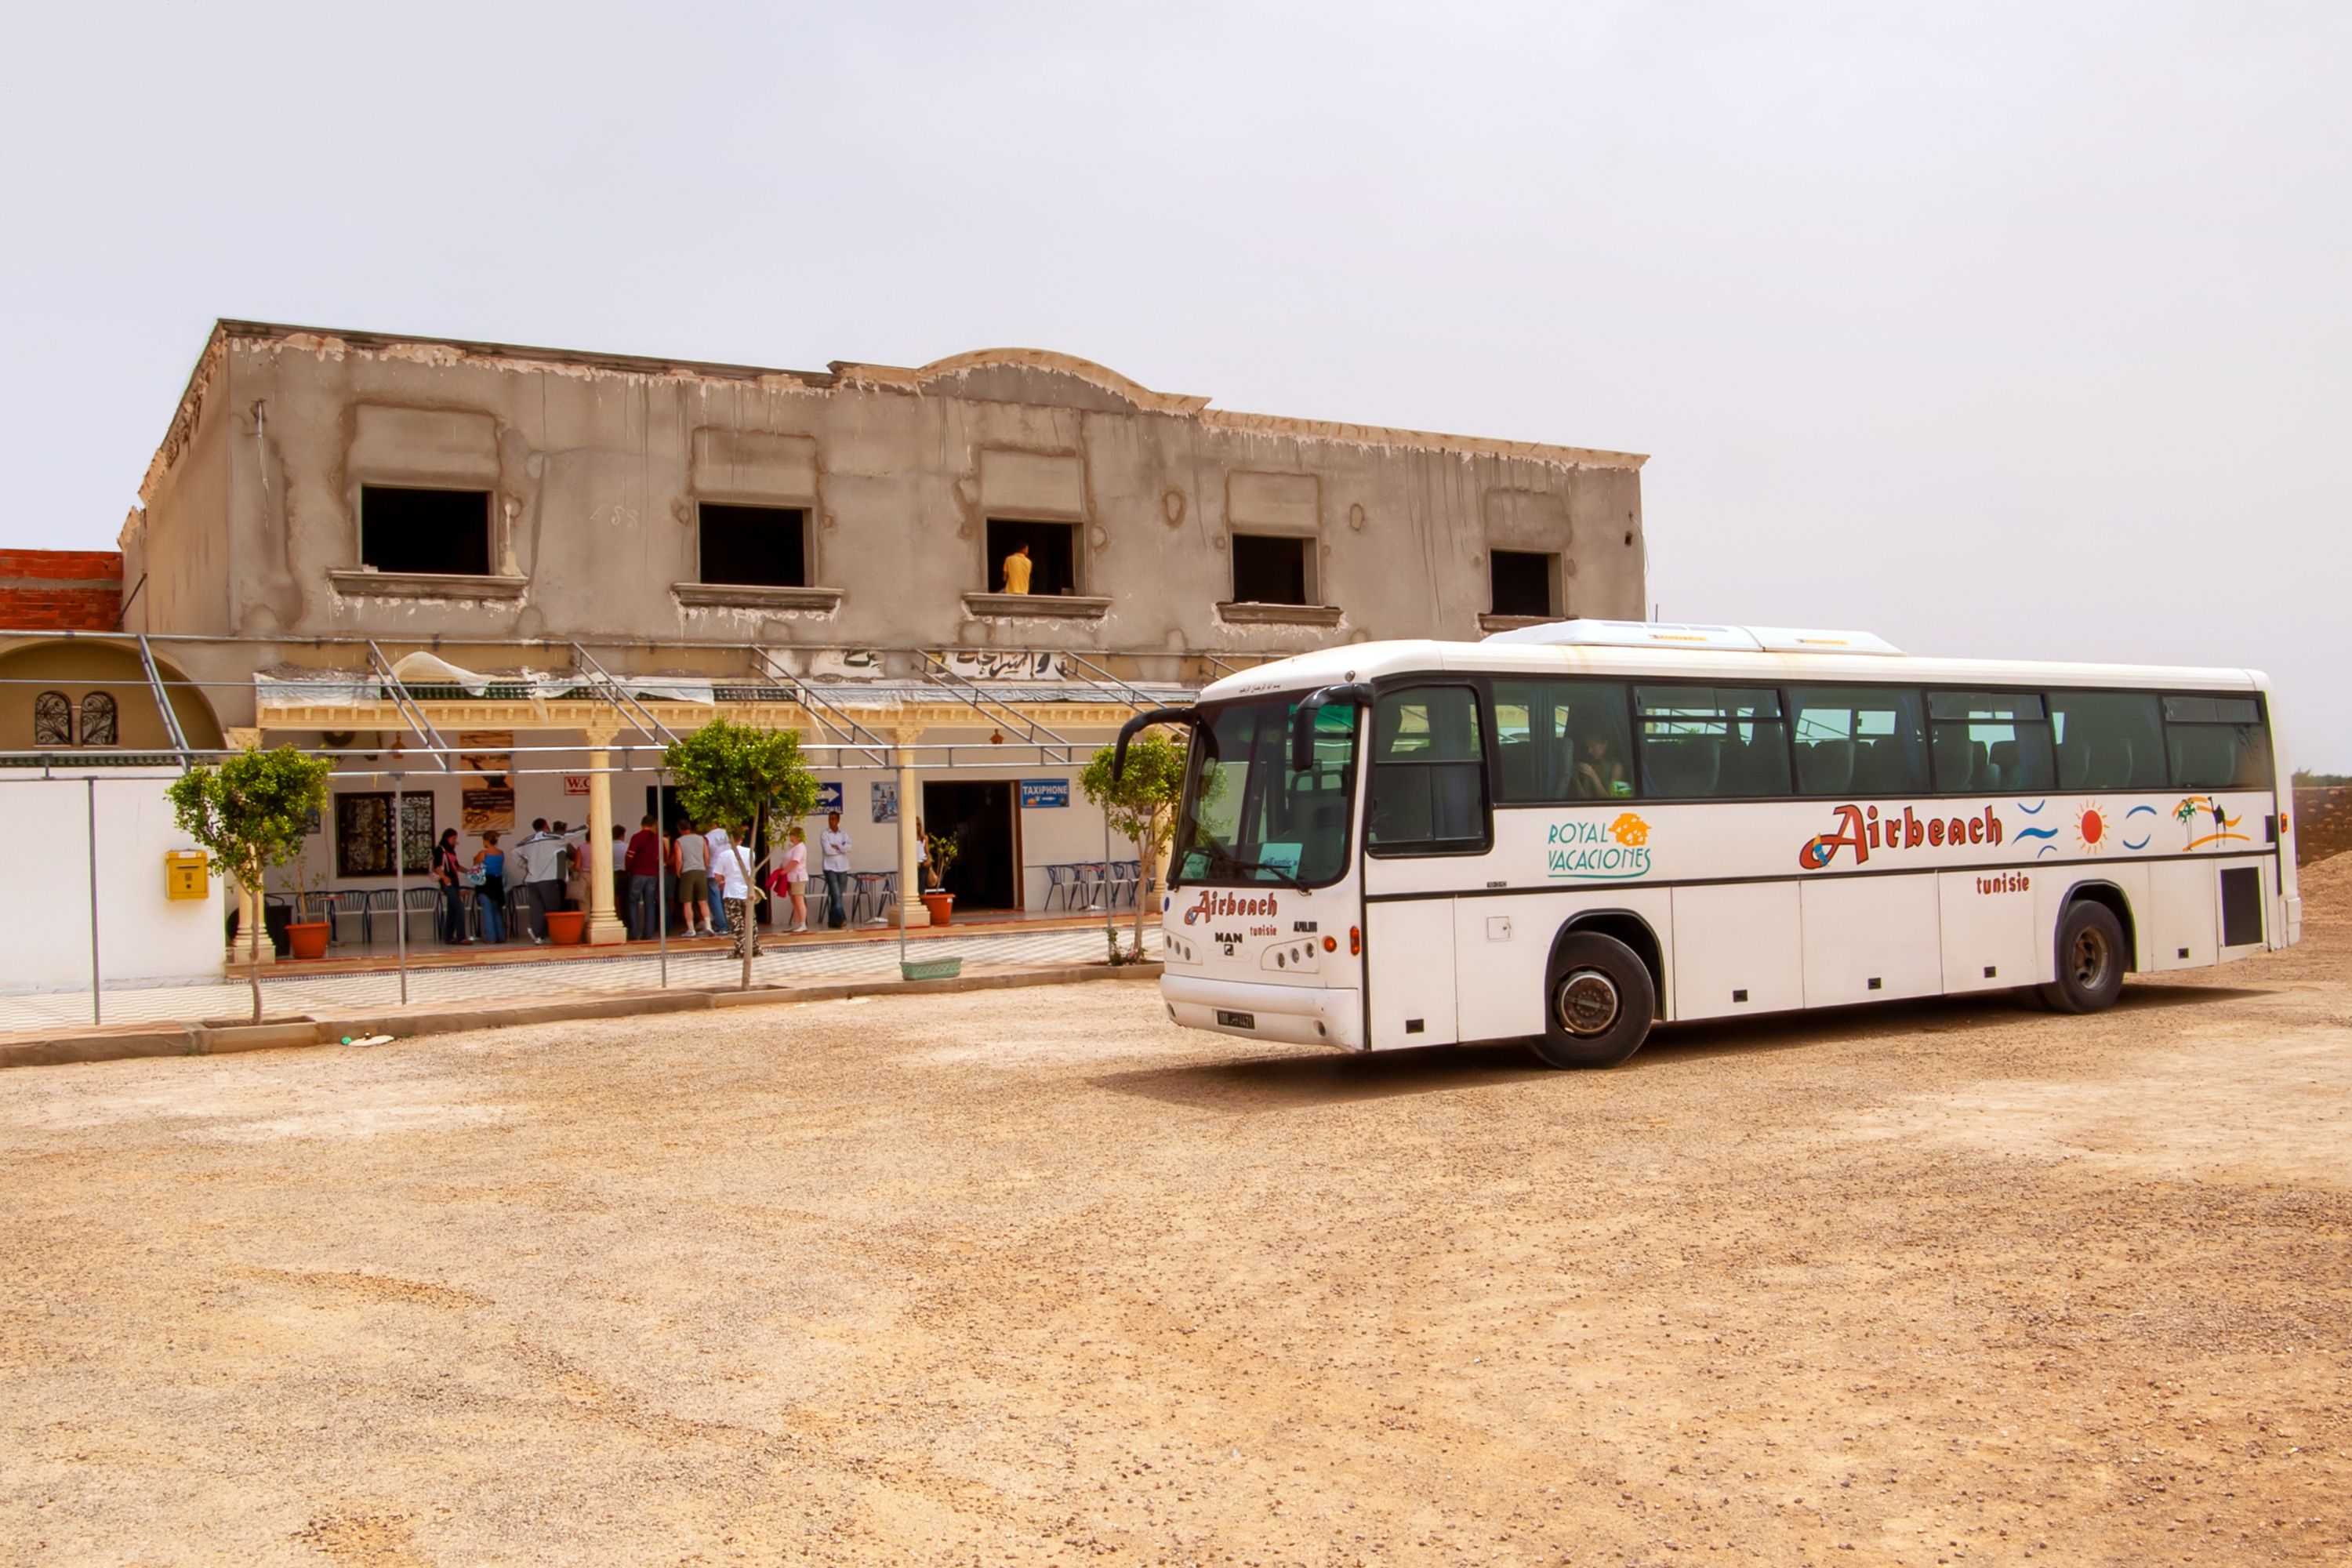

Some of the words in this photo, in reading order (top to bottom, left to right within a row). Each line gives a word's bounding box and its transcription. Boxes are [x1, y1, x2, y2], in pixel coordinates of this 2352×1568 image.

[1022, 786, 1069, 795] TAXIPHONE
[1548, 822, 1608, 844] ROYAL
[1799, 804, 2003, 869] Airbeach
[1548, 848, 1651, 876] VACACIONES
[1976, 871, 2030, 895] tunisie
[1184, 890, 1278, 926] Airbeach
[1215, 932, 1243, 944] MAN
[1250, 924, 1277, 937] tunisie
